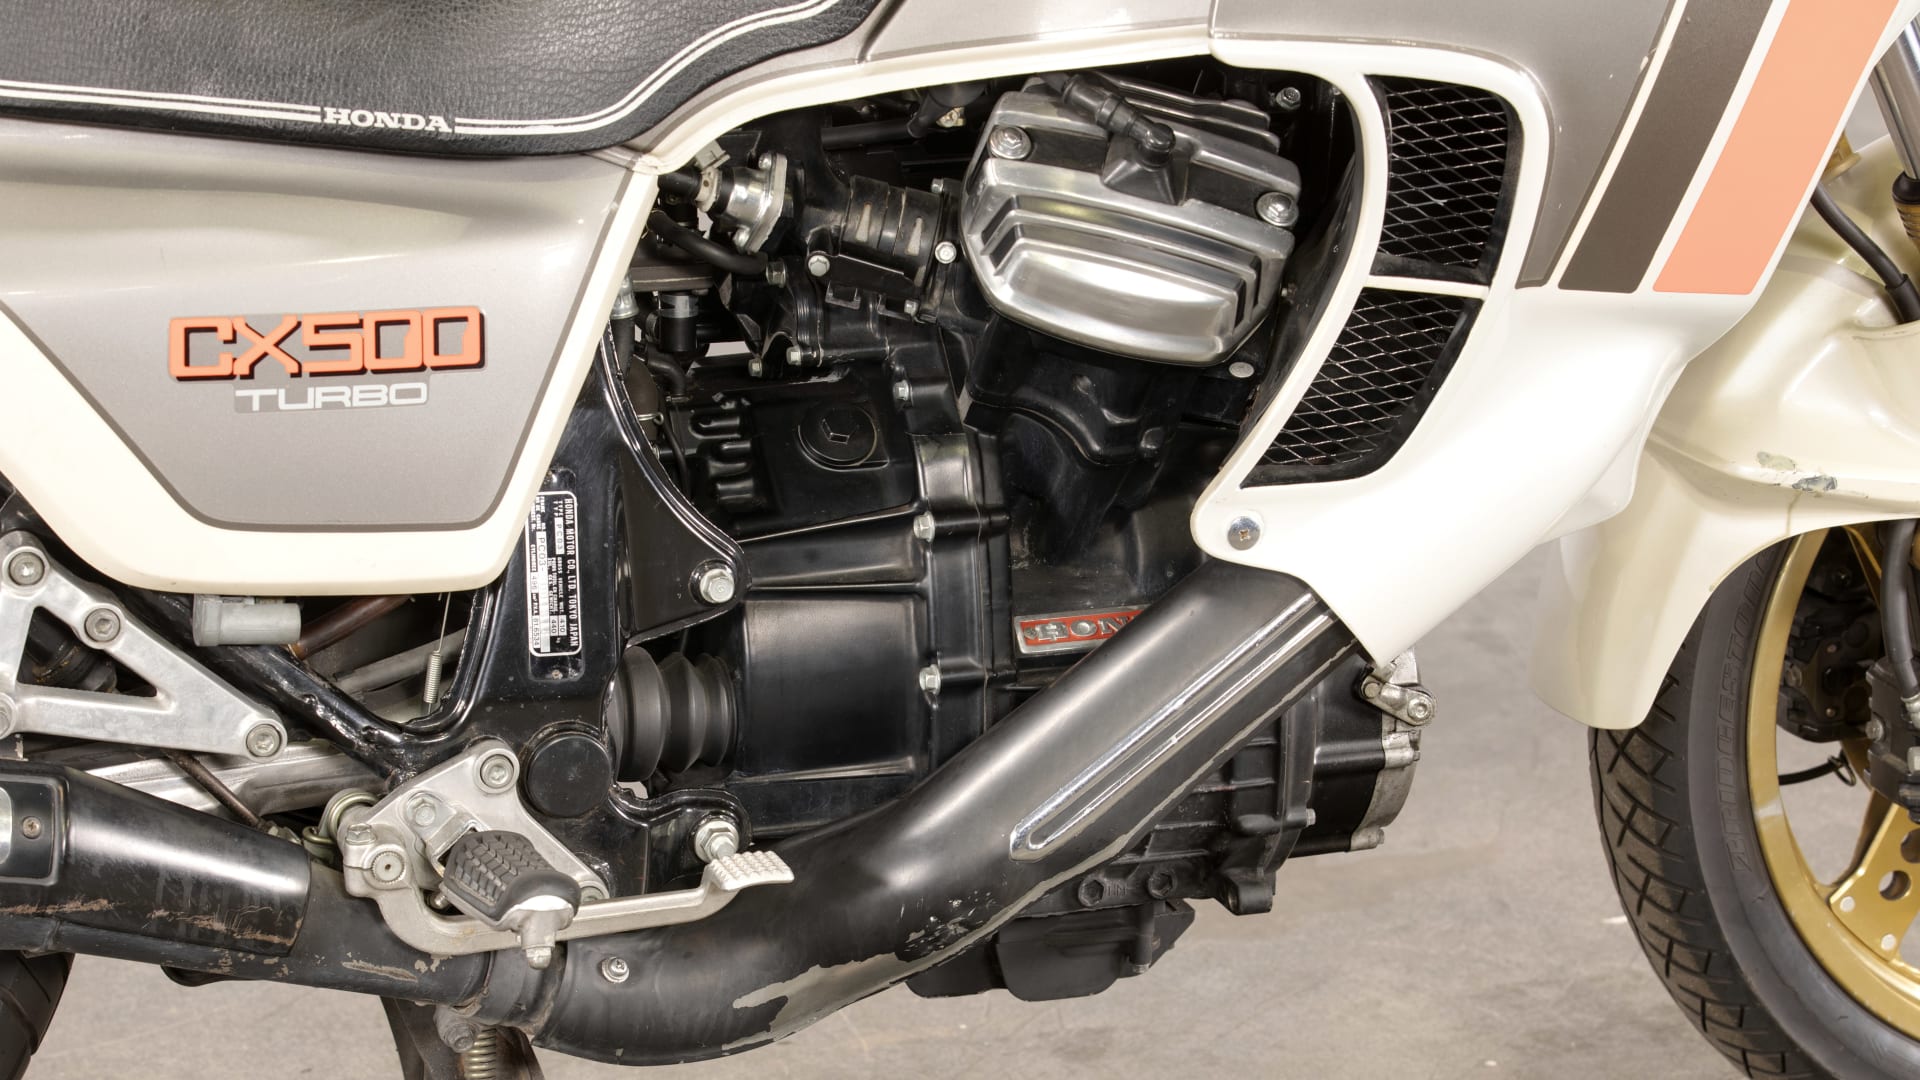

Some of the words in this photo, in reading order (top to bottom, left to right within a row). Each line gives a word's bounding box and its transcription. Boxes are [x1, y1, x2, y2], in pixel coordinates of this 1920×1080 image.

[323, 106, 453, 133] HONDA
[168, 305, 487, 382] CX500
[234, 381, 429, 412] TURBO
[565, 499, 573, 524] HONDA
[566, 529, 575, 555] MOTOR
[568, 576, 576, 591] LTD.
[569, 594, 577, 619] TOKYO
[570, 624, 578, 646] JAPAN
[1035, 615, 1134, 642] HON
